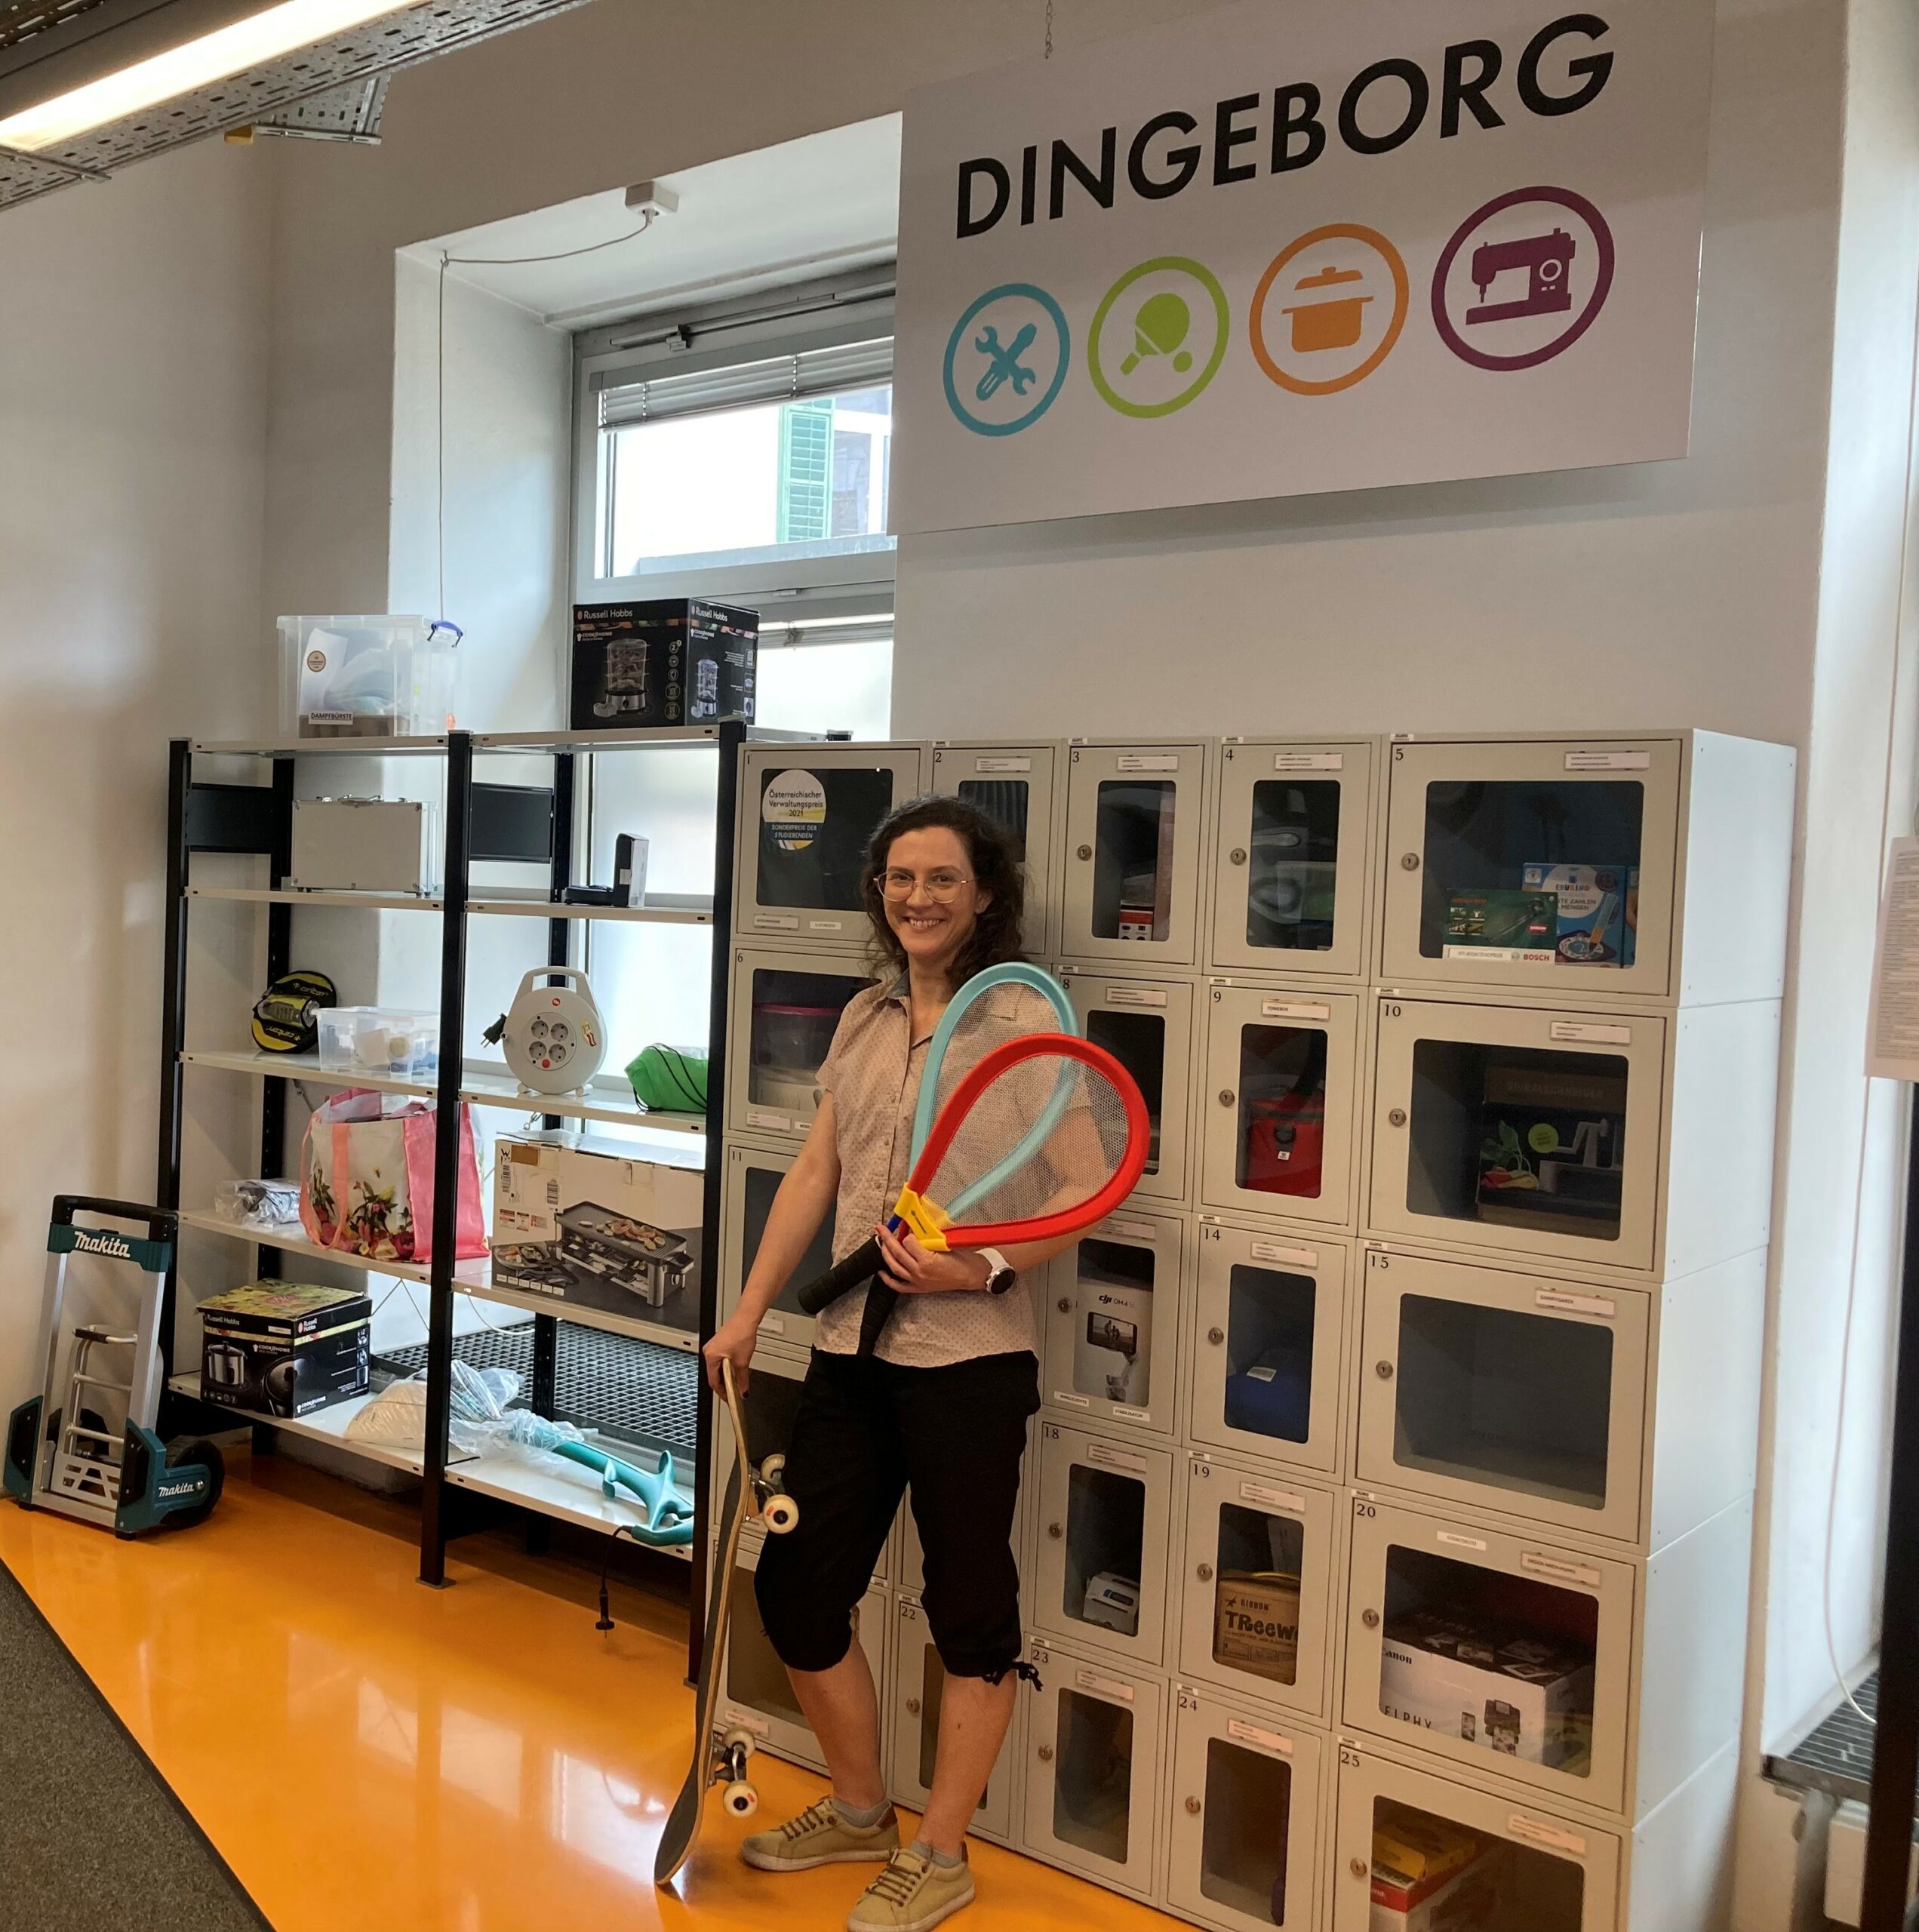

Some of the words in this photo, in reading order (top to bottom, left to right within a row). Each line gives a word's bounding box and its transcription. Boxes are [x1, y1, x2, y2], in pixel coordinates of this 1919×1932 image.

[955, 13, 1614, 239] DINGEBORG
[583, 610, 608, 620] Russell
[610, 609, 633, 617] Hobbs
[696, 605, 713, 617] Russell
[713, 611, 728, 622] Hobbs
[935, 752, 942, 763] 2
[1072, 751, 1080, 763] 3
[1225, 749, 1234, 761] 4
[1395, 748, 1404, 761] 5
[769, 789, 822, 798] Österreichischer
[769, 800, 823, 810] Verwaltungspreis
[737, 952, 743, 962] 6
[1523, 953, 1550, 961] BOSCH
[1063, 978, 1070, 989] 8
[1213, 991, 1222, 1003] 9
[1385, 1004, 1401, 1017] 10
[731, 1151, 742, 1162] 11
[1204, 1227, 1221, 1241] 14
[1372, 1255, 1389, 1269] 15
[223, 1318, 240, 1326] Hobbs
[1044, 1426, 1059, 1440] 18
[1193, 1463, 1210, 1478] 19
[1356, 1503, 1376, 1518] 20
[901, 1606, 915, 1620] 22
[1032, 1648, 1050, 1664] 23
[1179, 1696, 1197, 1712] 24
[1340, 1751, 1360, 1767] 25
